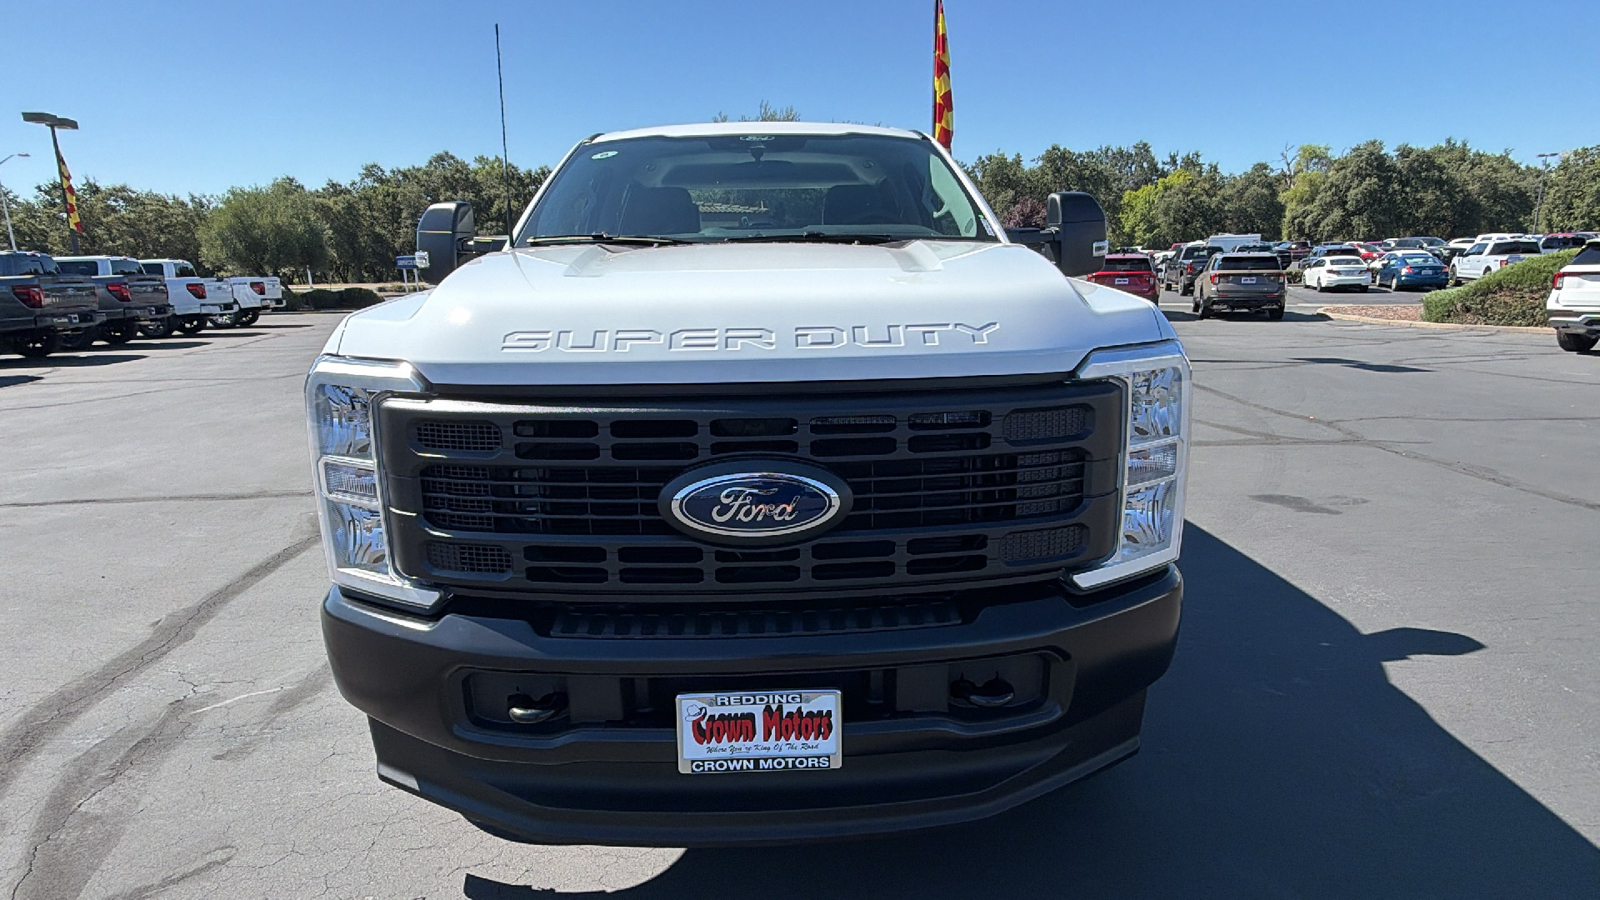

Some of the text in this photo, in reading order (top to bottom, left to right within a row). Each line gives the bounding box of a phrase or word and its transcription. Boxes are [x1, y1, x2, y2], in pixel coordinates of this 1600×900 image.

[501, 322, 999, 353] SUPER DUTY
[711, 487, 801, 523] Ford
[716, 694, 801, 706] REDDING
[692, 704, 833, 745] Crown Motors
[754, 743, 771, 752] King
[774, 743, 783, 752] Of
[785, 743, 798, 751] The
[692, 757, 830, 772] CROWN MOTORS
